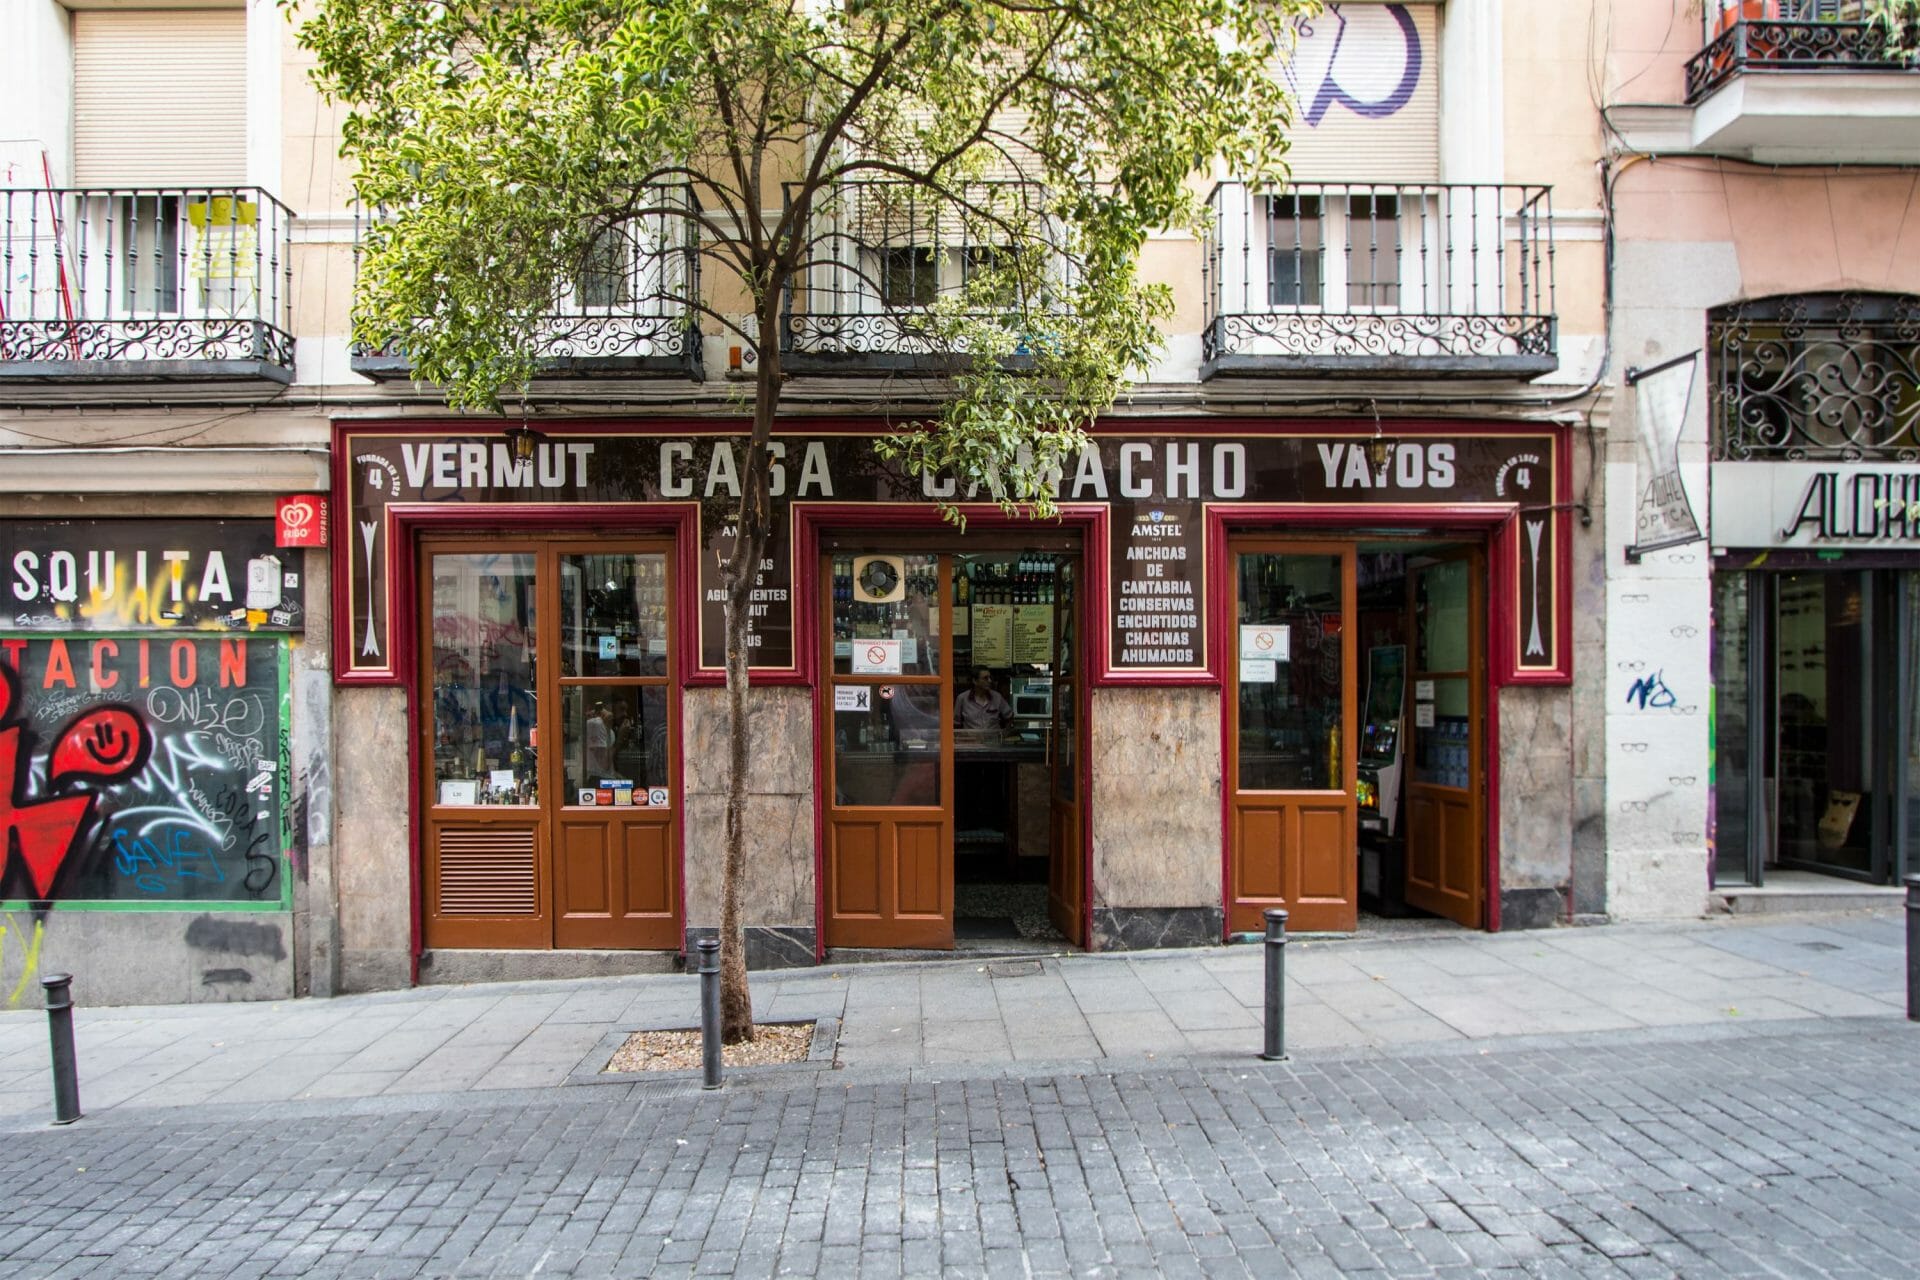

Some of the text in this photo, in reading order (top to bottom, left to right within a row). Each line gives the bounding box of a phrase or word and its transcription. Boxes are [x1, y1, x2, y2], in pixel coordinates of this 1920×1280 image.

[401, 443, 595, 488] VERMUT
[660, 441, 834, 497] CASA
[1317, 443, 1455, 488] YAYOS
[368, 468, 383, 489] 4
[1516, 468, 1531, 489] 4
[283, 528, 308, 538] FRIGO
[1131, 524, 1181, 536] AMSTEL
[1126, 546, 1187, 560] ANCHOAS
[1146, 563, 1164, 577] DE
[706, 589, 788, 601] AGUIENTES
[1121, 580, 1193, 595] CANTABRIA
[1119, 597, 1195, 612] CONSERVAS
[1117, 614, 1197, 629] ENCURTIDOS
[1125, 632, 1190, 646] CHACINAS
[1121, 649, 1194, 663] AHUMADOS
